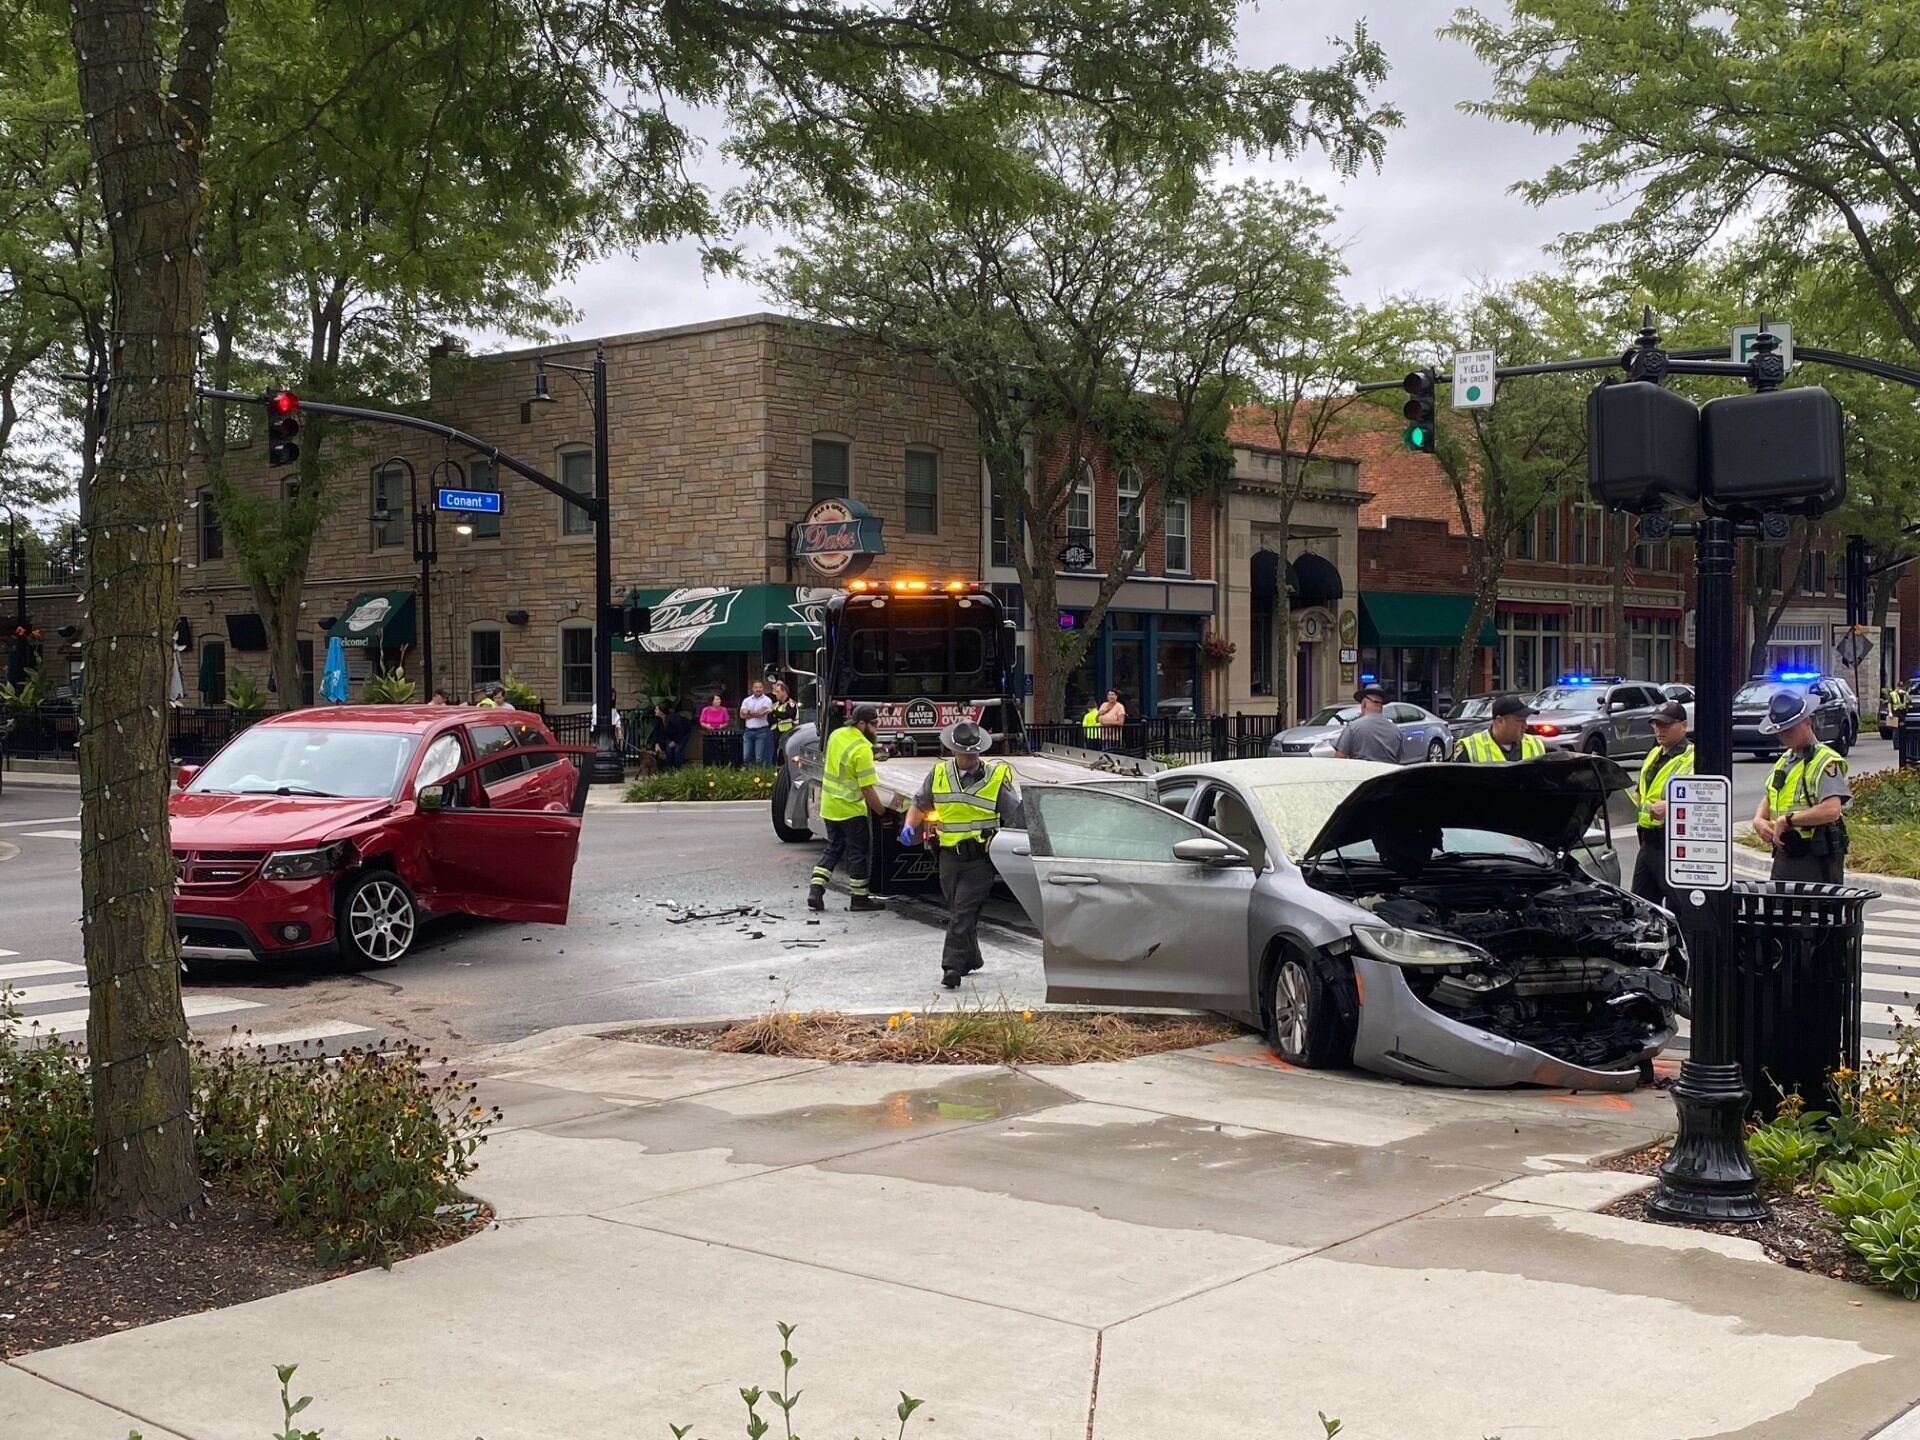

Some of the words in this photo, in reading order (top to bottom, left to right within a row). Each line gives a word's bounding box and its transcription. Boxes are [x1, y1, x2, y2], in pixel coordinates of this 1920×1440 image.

[1459, 355, 1472, 364] LEFT
[1464, 364, 1485, 374] YIELD
[1470, 375, 1488, 383] GREEN
[446, 494, 482, 507] Conant
[341, 637, 368, 646] elcome!
[941, 706, 976, 715] MOVE
